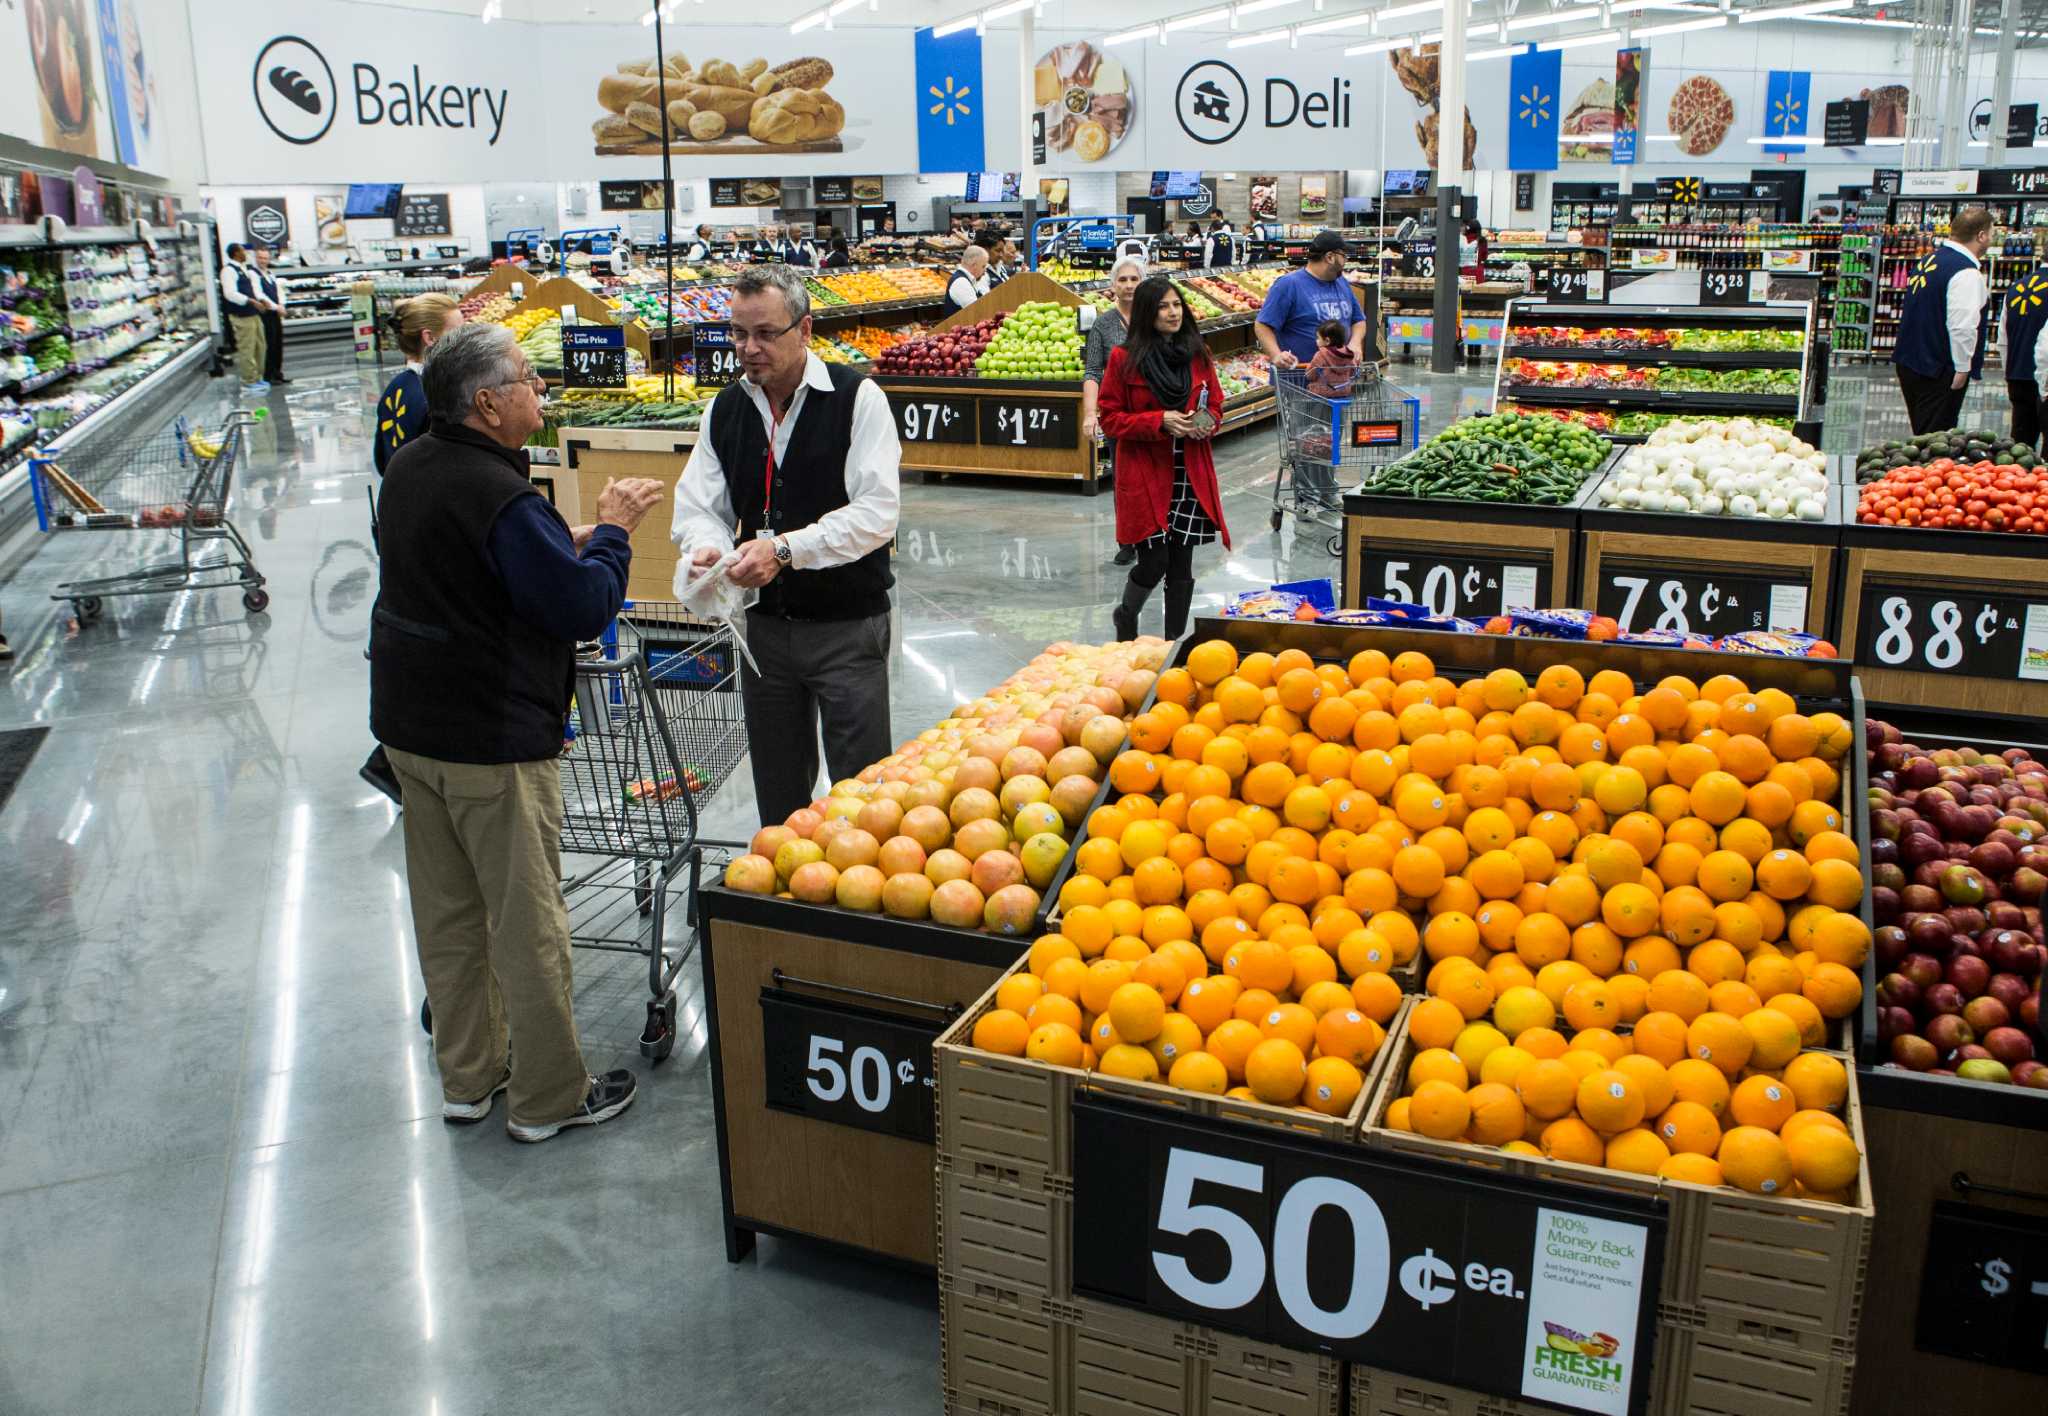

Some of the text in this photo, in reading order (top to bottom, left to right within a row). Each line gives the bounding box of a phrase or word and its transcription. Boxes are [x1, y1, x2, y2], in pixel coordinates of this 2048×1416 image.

[352, 63, 507, 146] Bakery
[1265, 77, 1350, 128] Deli
[1706, 274, 1743, 296] $328
[574, 335, 589, 344] Low
[590, 335, 608, 344] Price
[709, 333, 724, 343] Low
[904, 403, 952, 440] 97¢
[1384, 560, 1481, 618] 50¢
[1612, 575, 1720, 634] 78¢
[1875, 596, 1999, 668] 88¢
[806, 1034, 916, 1113] 50¢
[1152, 1146, 1525, 1339] 50¢ ea.
[1551, 1215, 1589, 1234] 100%
[1545, 1243, 1621, 1270] Guarantee
[1547, 1229, 1635, 1259] Money Back
[1532, 1367, 1607, 1392] GUARANTEE
[1535, 1346, 1622, 1383] FRESH
